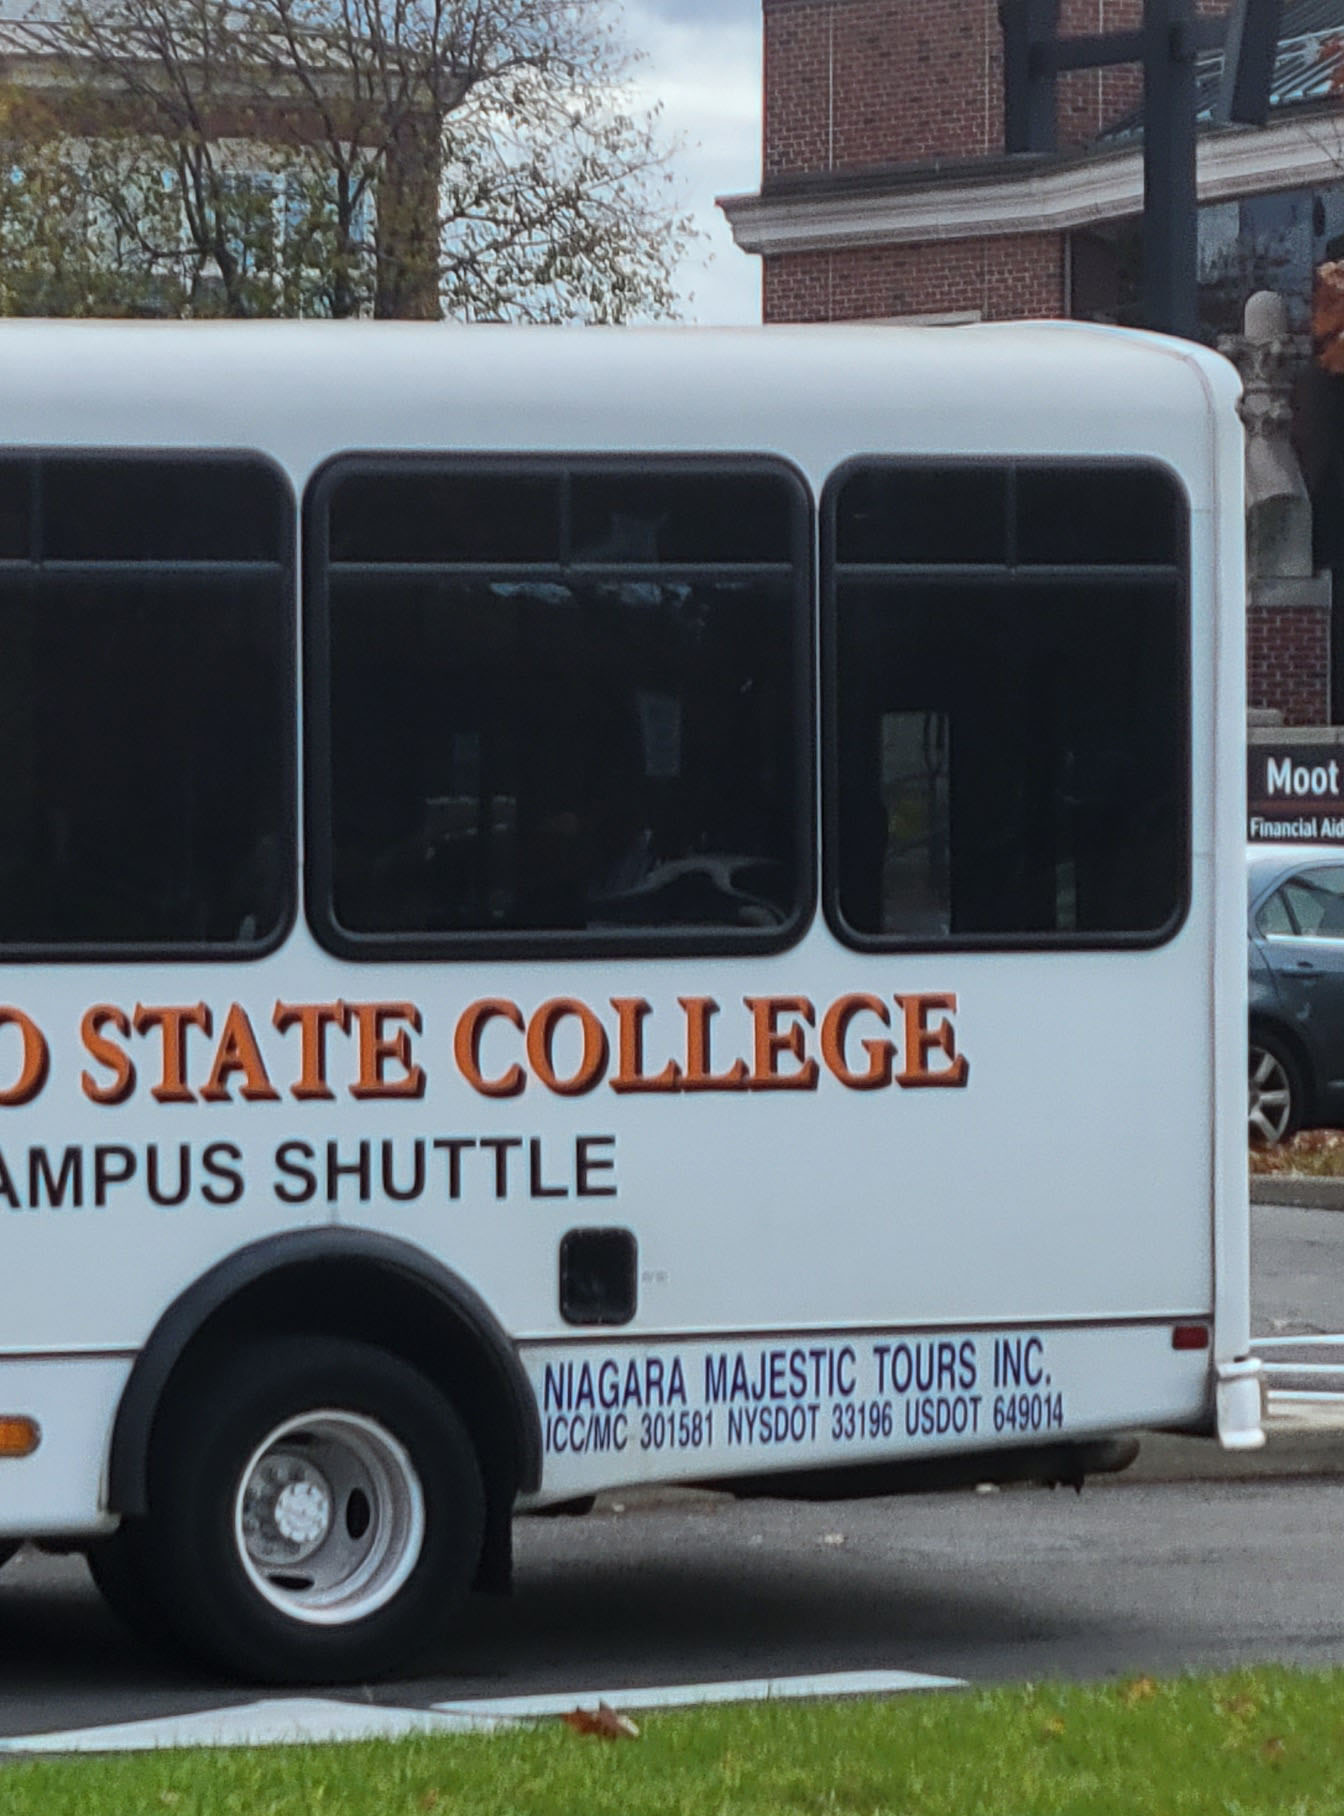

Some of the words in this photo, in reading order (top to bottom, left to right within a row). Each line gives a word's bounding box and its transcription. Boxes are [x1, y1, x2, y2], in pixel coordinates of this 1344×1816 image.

[1267, 757, 1339, 796] Moot
[1250, 817, 1318, 838] Financial
[79, 998, 426, 1107] STATE
[453, 992, 970, 1097] COLLEGE
[272, 1136, 619, 1206] SHUTTLE
[543, 1356, 688, 1412] NIAGARA
[705, 1345, 857, 1404] MAJESTIC
[873, 1340, 977, 1394] TOURS
[994, 1336, 1052, 1388] INC.
[545, 1411, 629, 1454] ICC/MC
[640, 1408, 713, 1452] 301581
[727, 1402, 820, 1446] NYSDOT
[831, 1400, 893, 1442] 33196
[905, 1394, 982, 1437] USDOT
[993, 1391, 1064, 1433] 649014
